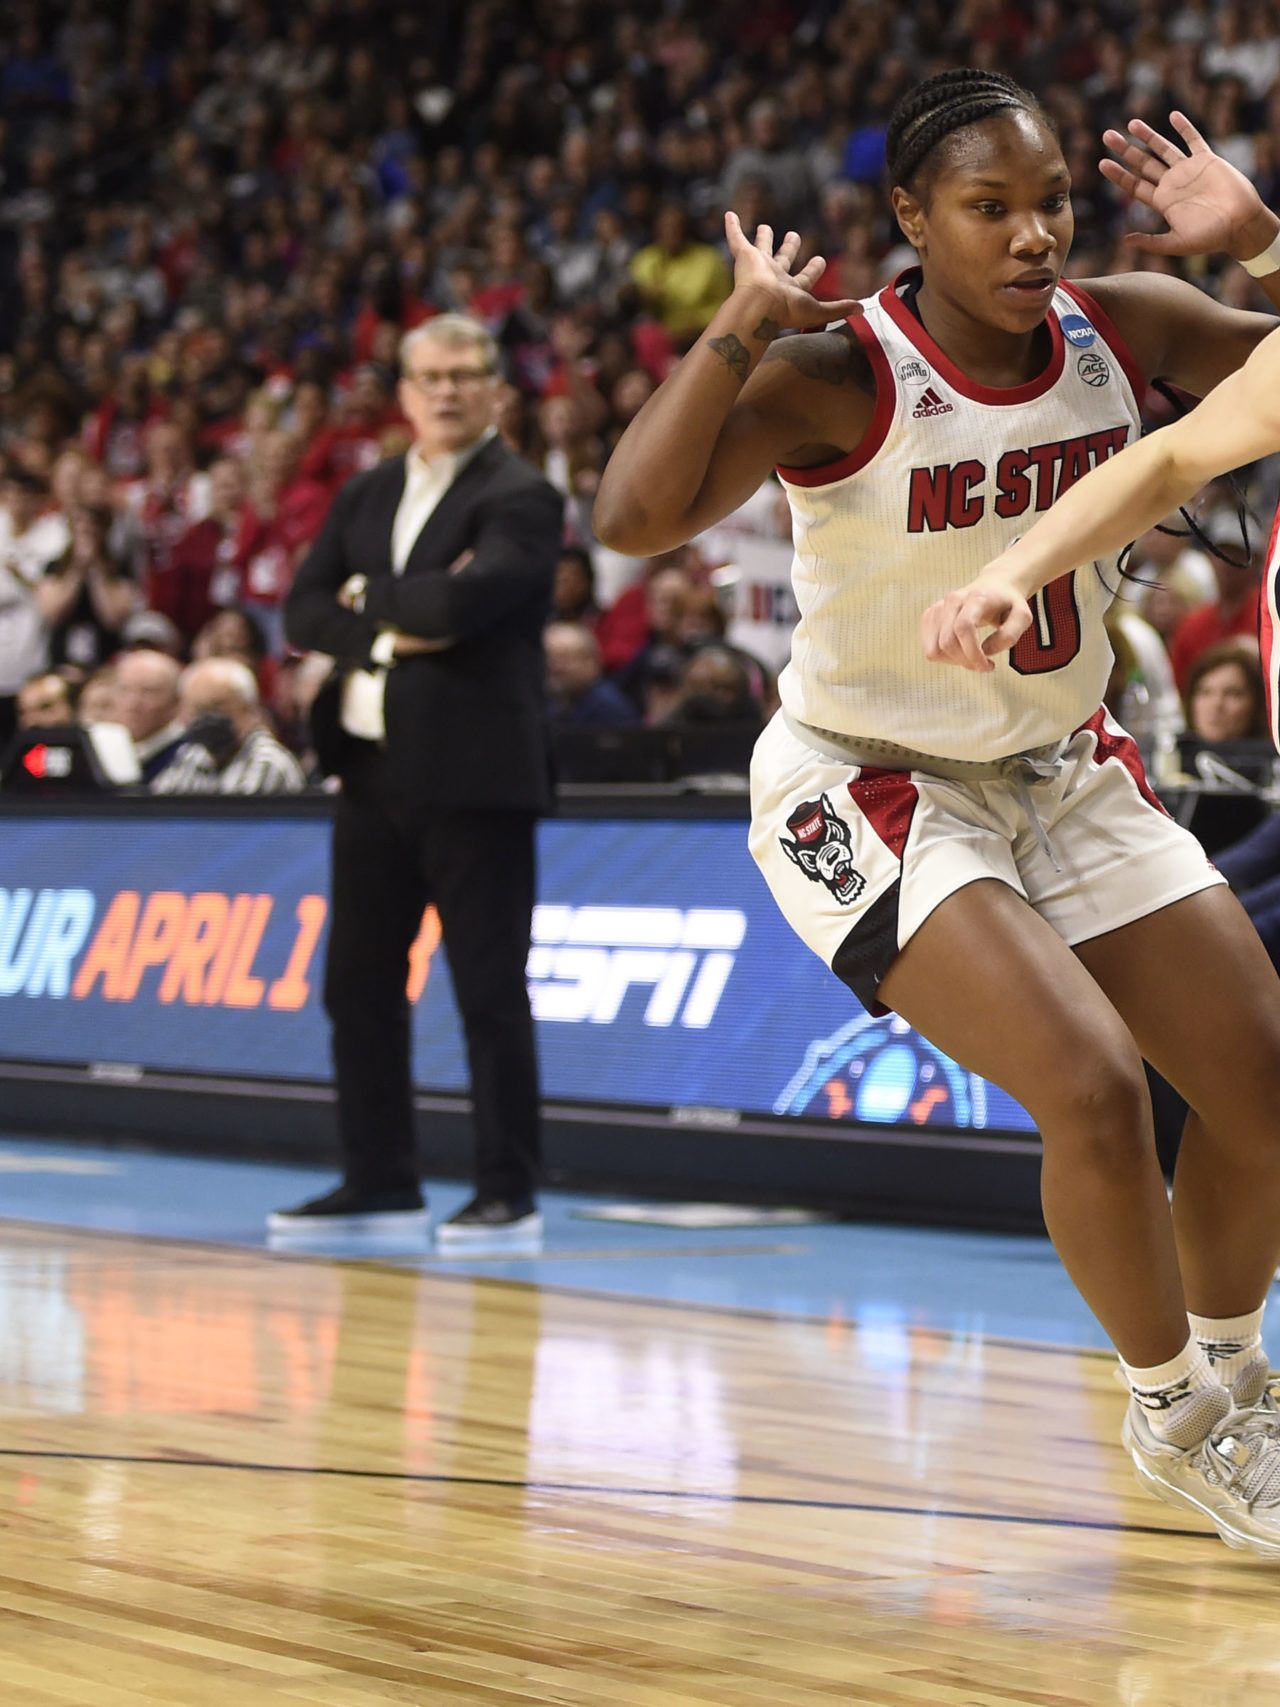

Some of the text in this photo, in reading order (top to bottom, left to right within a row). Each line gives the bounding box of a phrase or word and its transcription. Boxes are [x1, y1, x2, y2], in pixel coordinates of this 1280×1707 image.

[1067, 327, 1095, 339] NCAA
[901, 362, 920, 374] PACK
[1082, 362, 1105, 375] ACC
[900, 369, 927, 381] UNITED
[912, 403, 953, 418] adidas
[907, 459, 986, 533] NC
[70, 889, 274, 1010] APRIL
[267, 894, 327, 1012] 1
